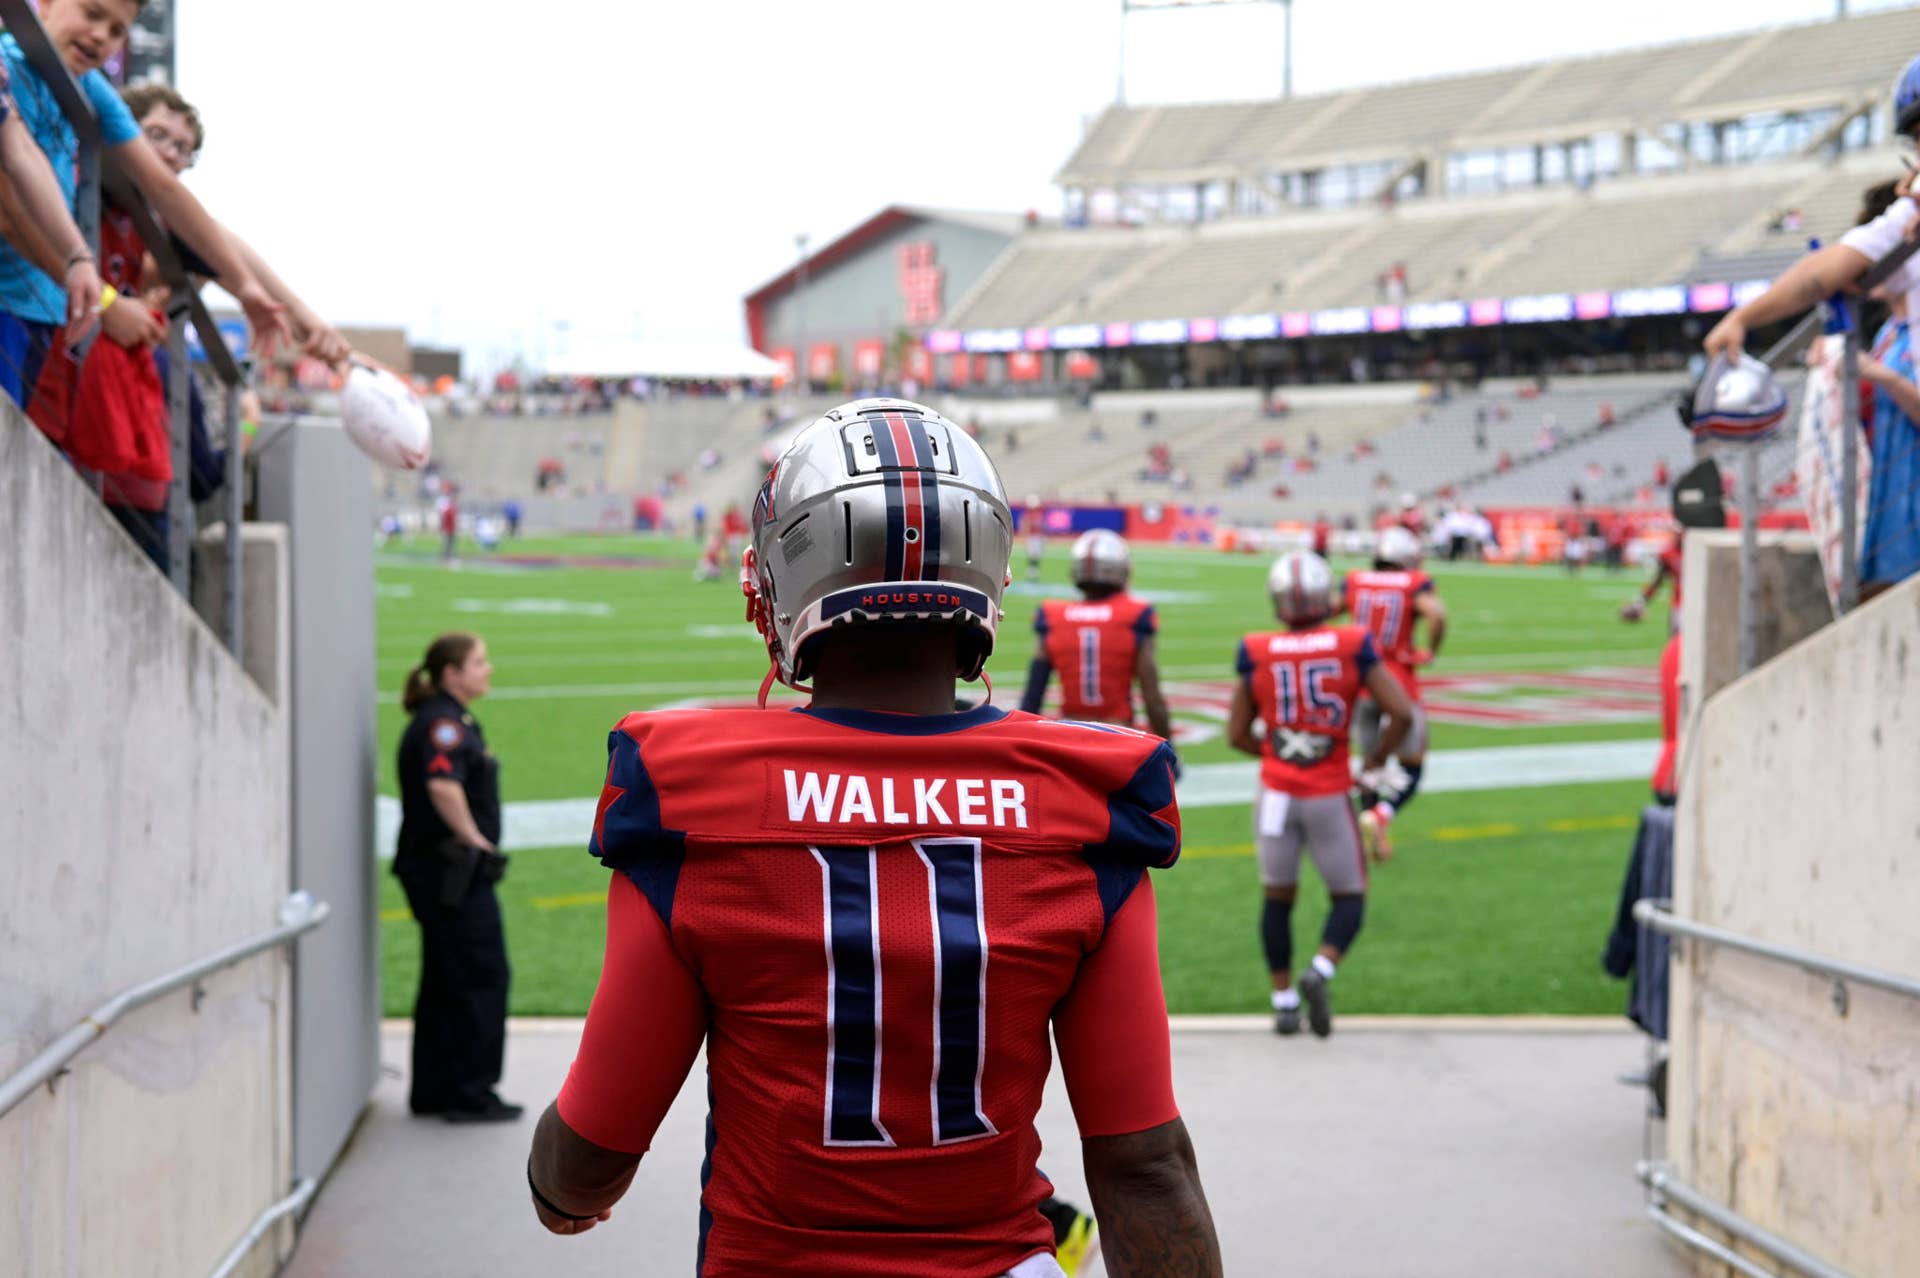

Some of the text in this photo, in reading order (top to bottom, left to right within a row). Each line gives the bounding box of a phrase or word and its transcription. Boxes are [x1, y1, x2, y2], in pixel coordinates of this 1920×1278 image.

[862, 592, 961, 607] HOUSTON
[1077, 626, 1104, 706] 1
[1270, 656, 1347, 729] 15
[783, 769, 1029, 829] WALKER
[807, 837, 999, 1147] 11
